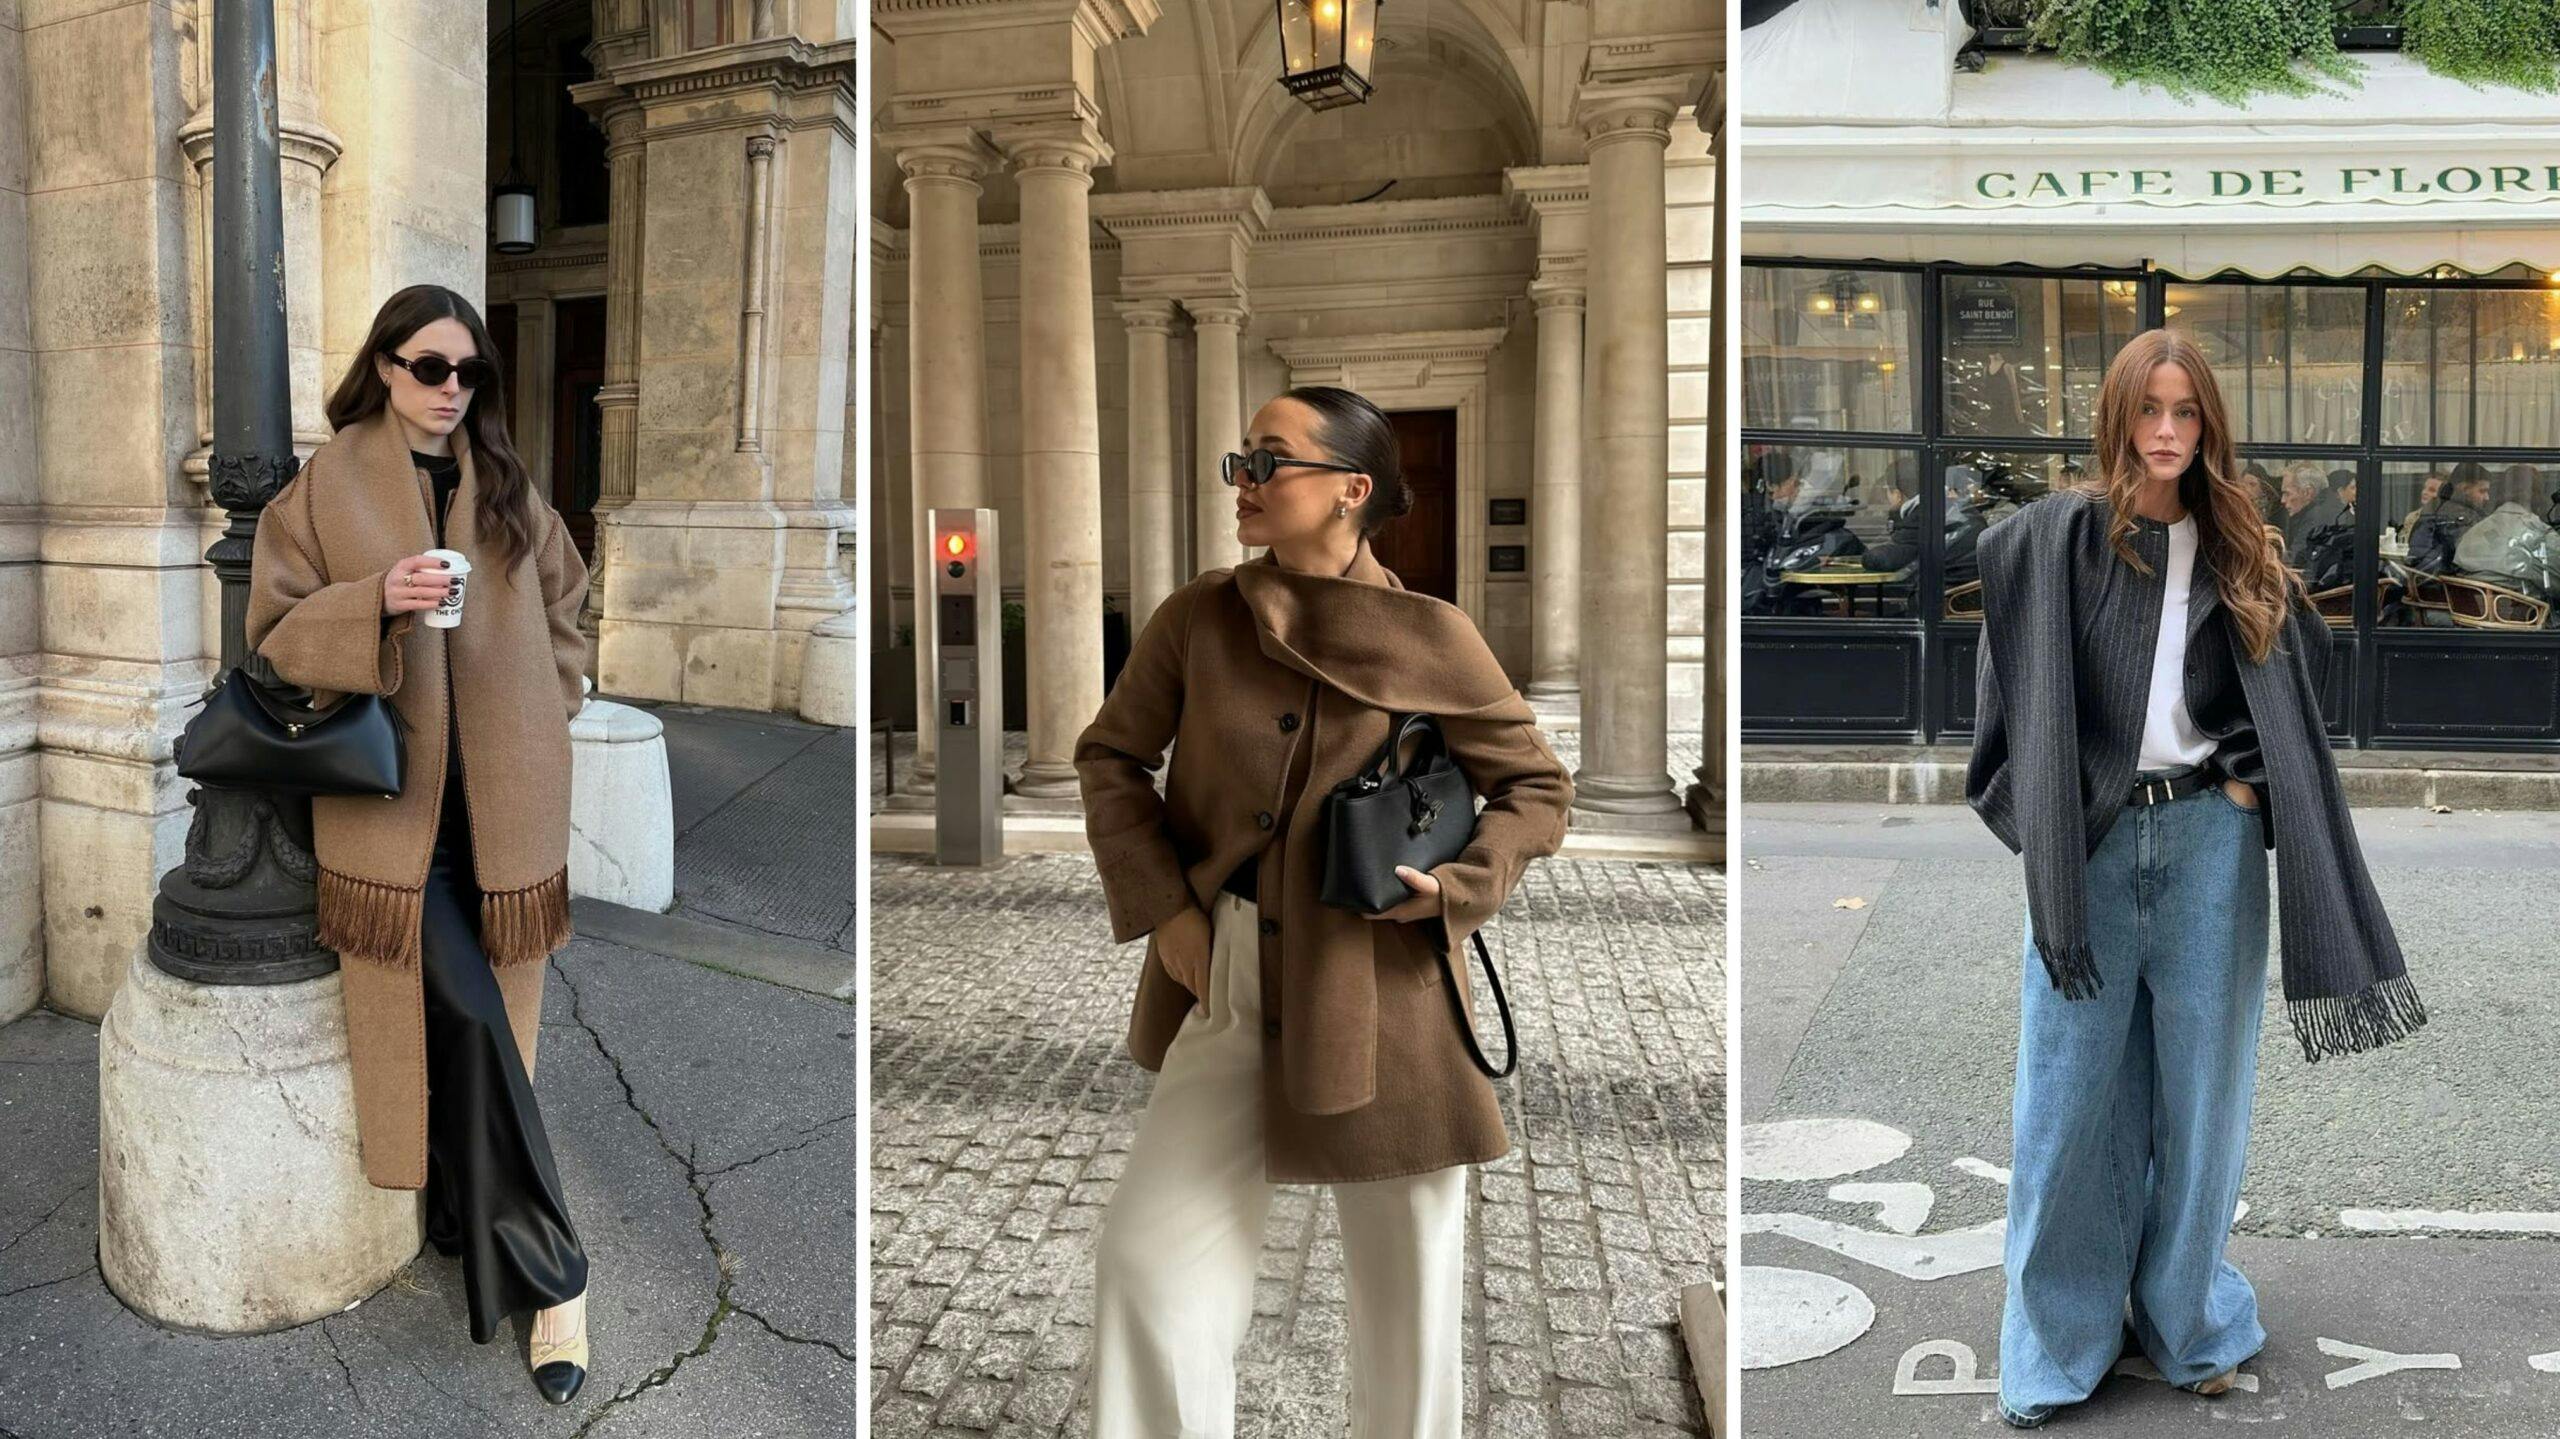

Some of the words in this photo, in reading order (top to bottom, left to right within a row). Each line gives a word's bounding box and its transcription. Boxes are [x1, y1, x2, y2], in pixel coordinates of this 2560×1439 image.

[1976, 170, 2173, 199] CAFE
[2208, 169, 2304, 197] DE
[1977, 299, 1995, 308] RUE
[1960, 310, 1983, 319] SAINT
